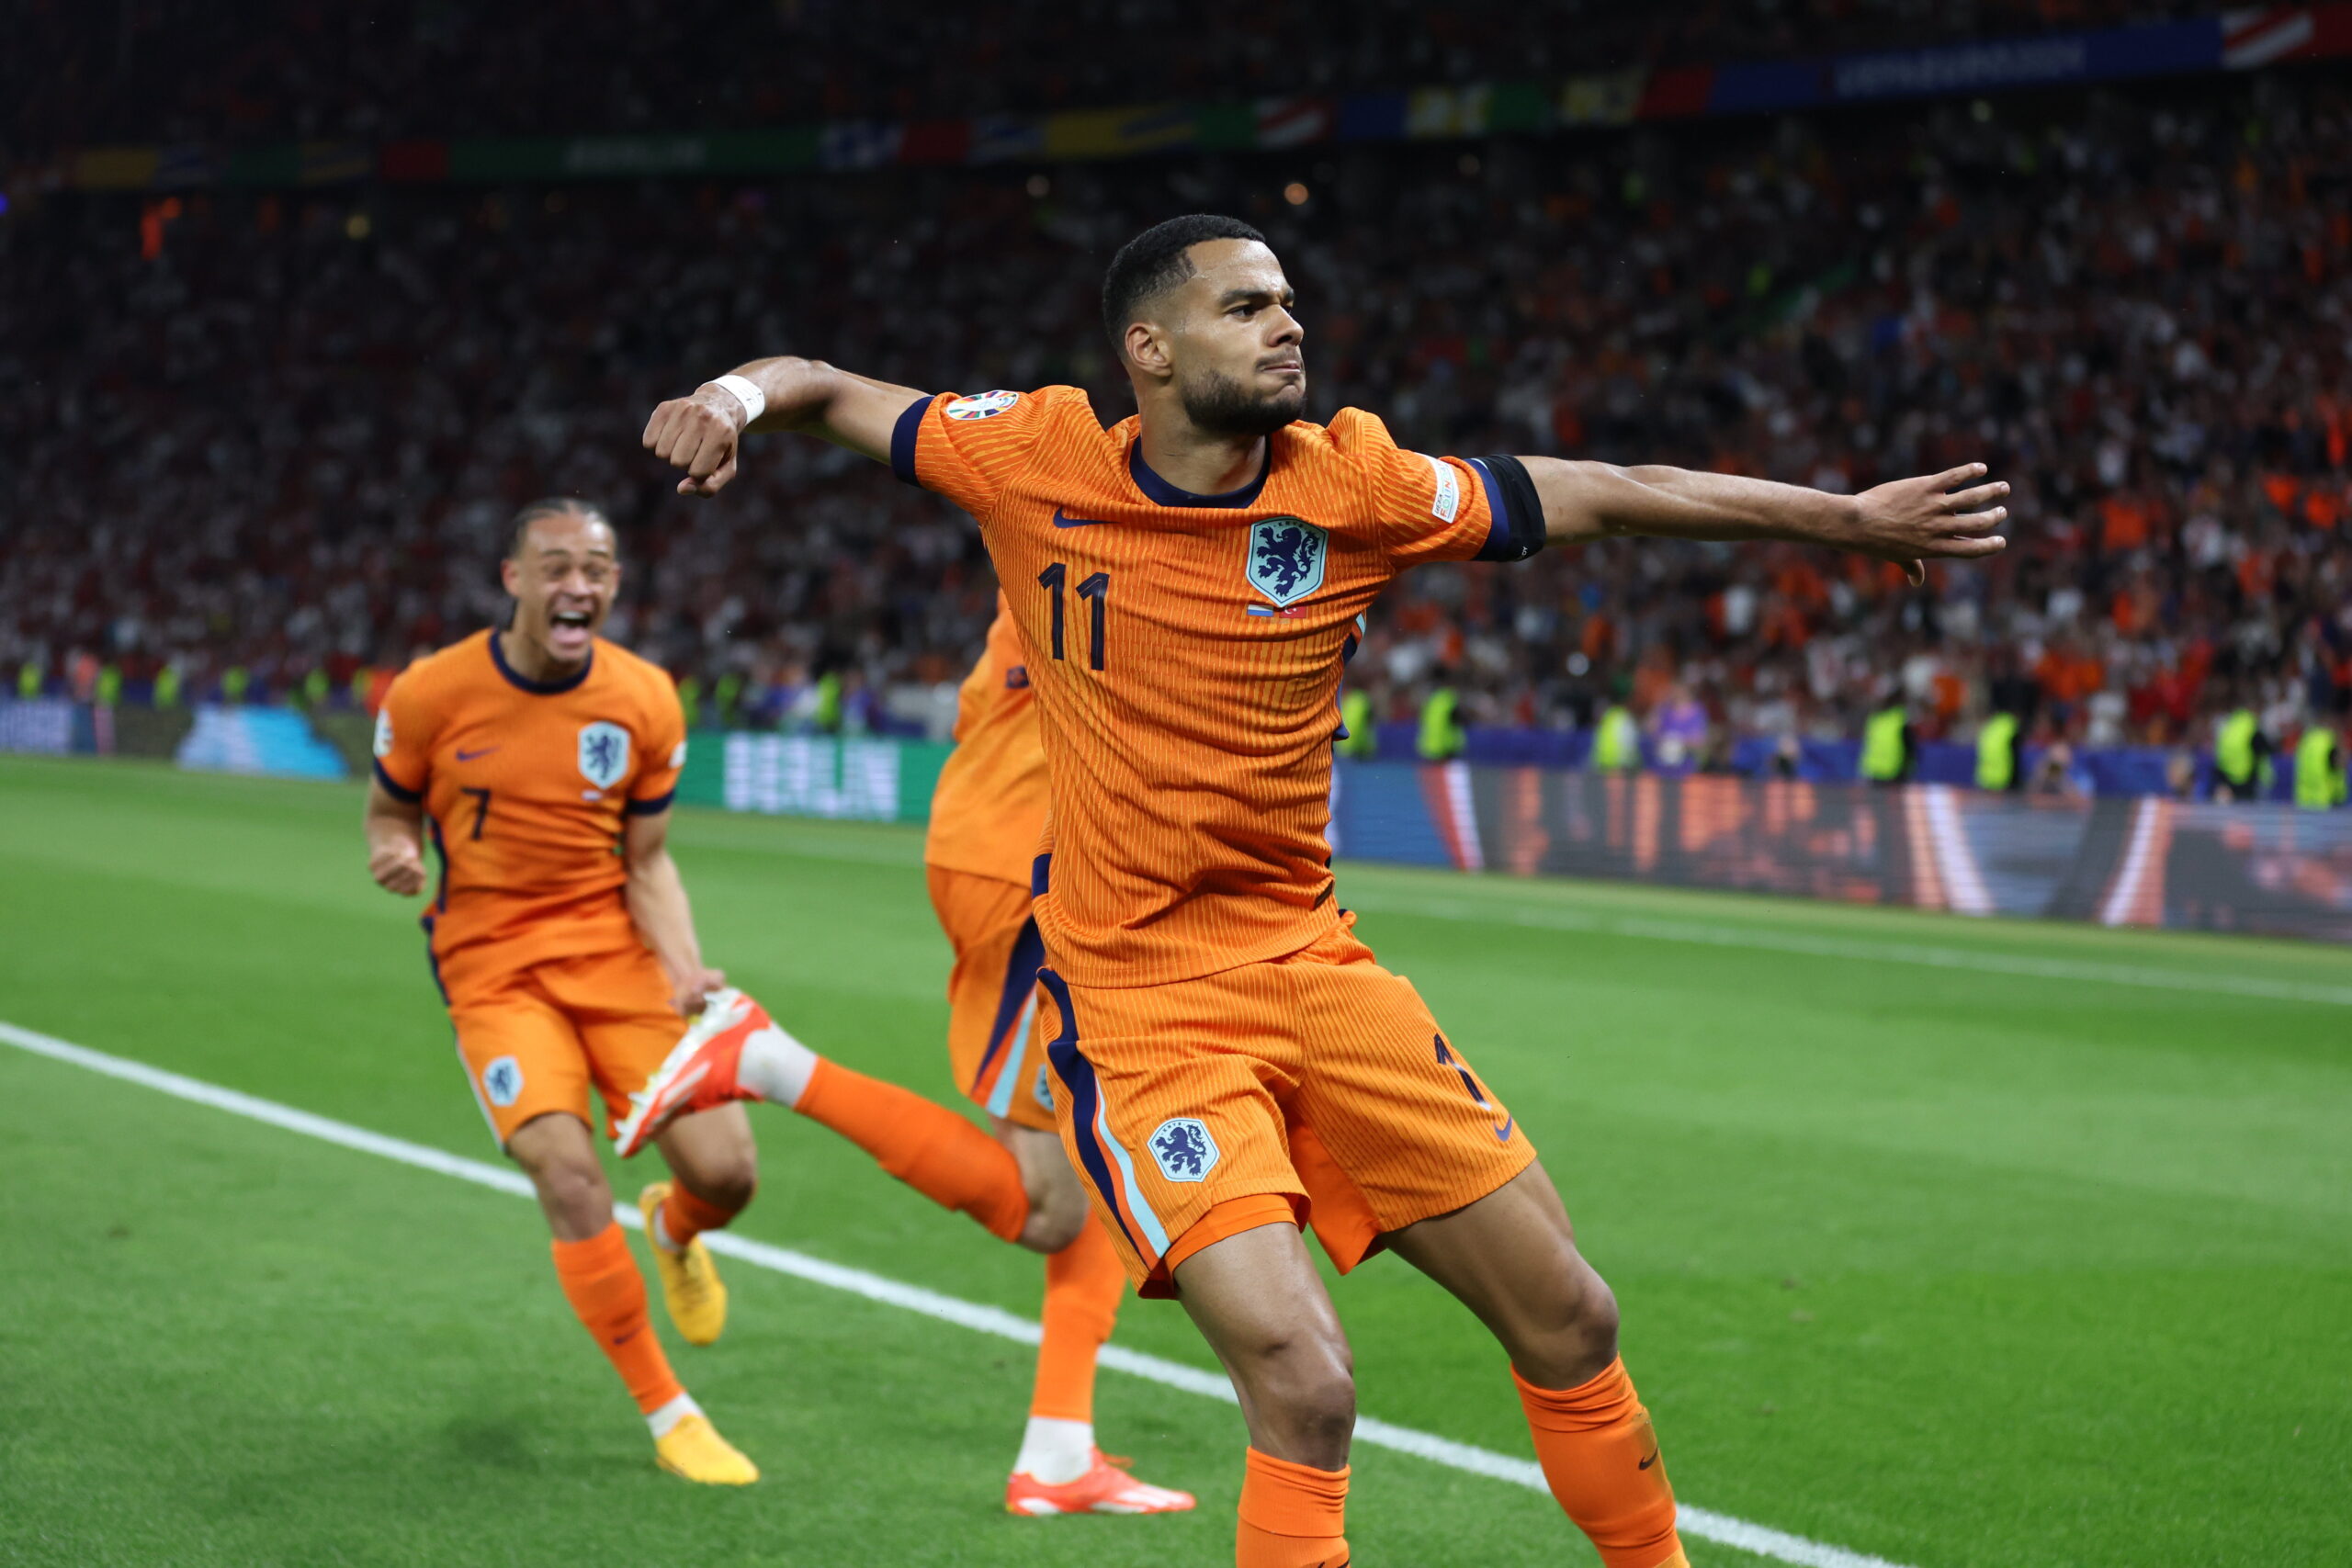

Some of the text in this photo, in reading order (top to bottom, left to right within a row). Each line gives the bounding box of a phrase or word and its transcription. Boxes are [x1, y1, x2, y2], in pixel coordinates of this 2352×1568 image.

[1038, 562, 1110, 671] 11
[460, 787, 492, 841] 7
[1434, 1033, 1492, 1111] 1
